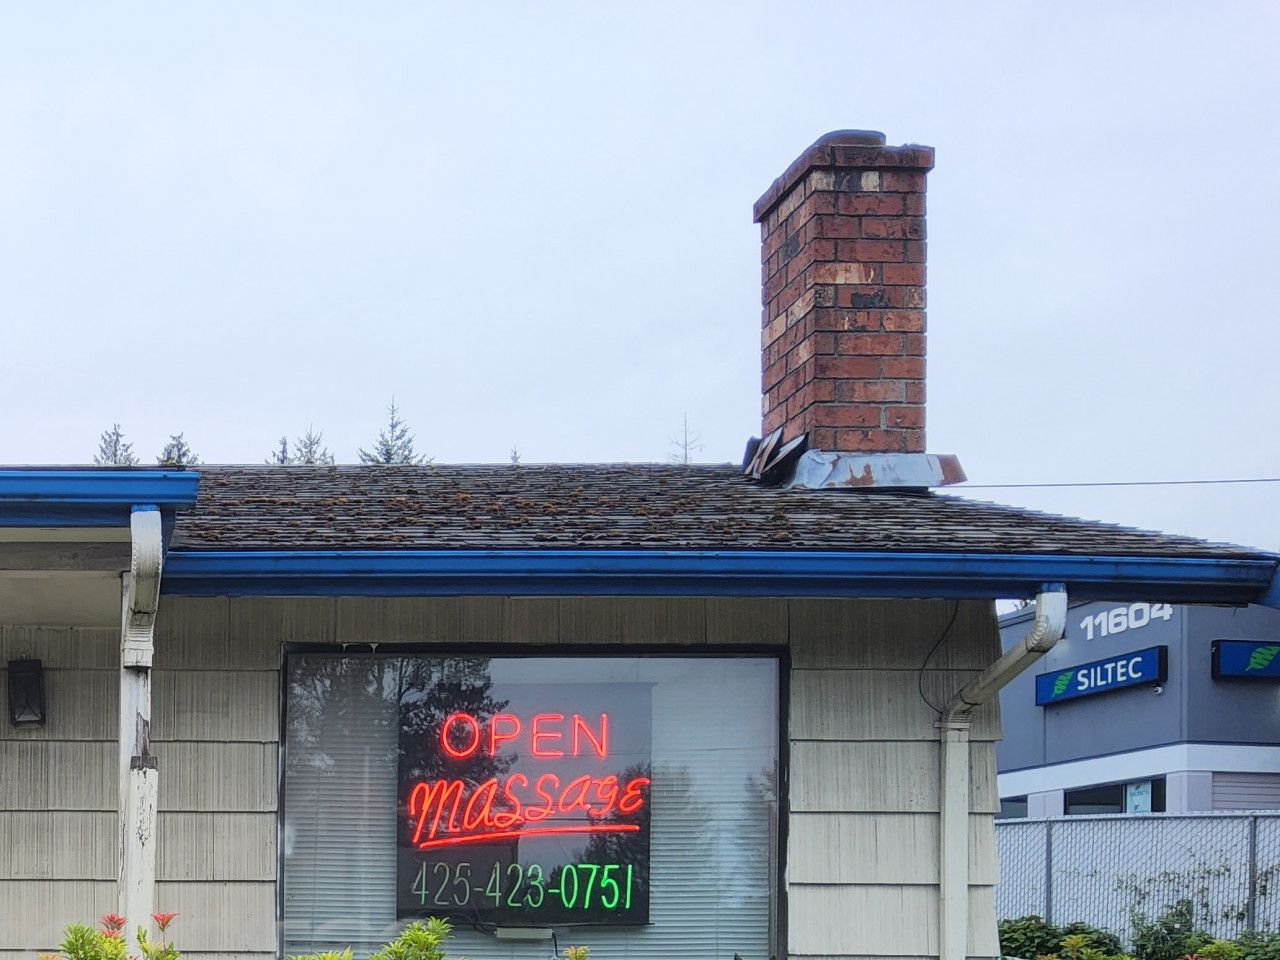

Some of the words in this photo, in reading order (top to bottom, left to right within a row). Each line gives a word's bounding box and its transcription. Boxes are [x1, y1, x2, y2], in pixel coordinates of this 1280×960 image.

[1080, 603, 1173, 641] 11604
[1077, 656, 1143, 691] SILTEC
[441, 713, 609, 759] OPEN
[411, 861, 634, 910] 425-423-0751
